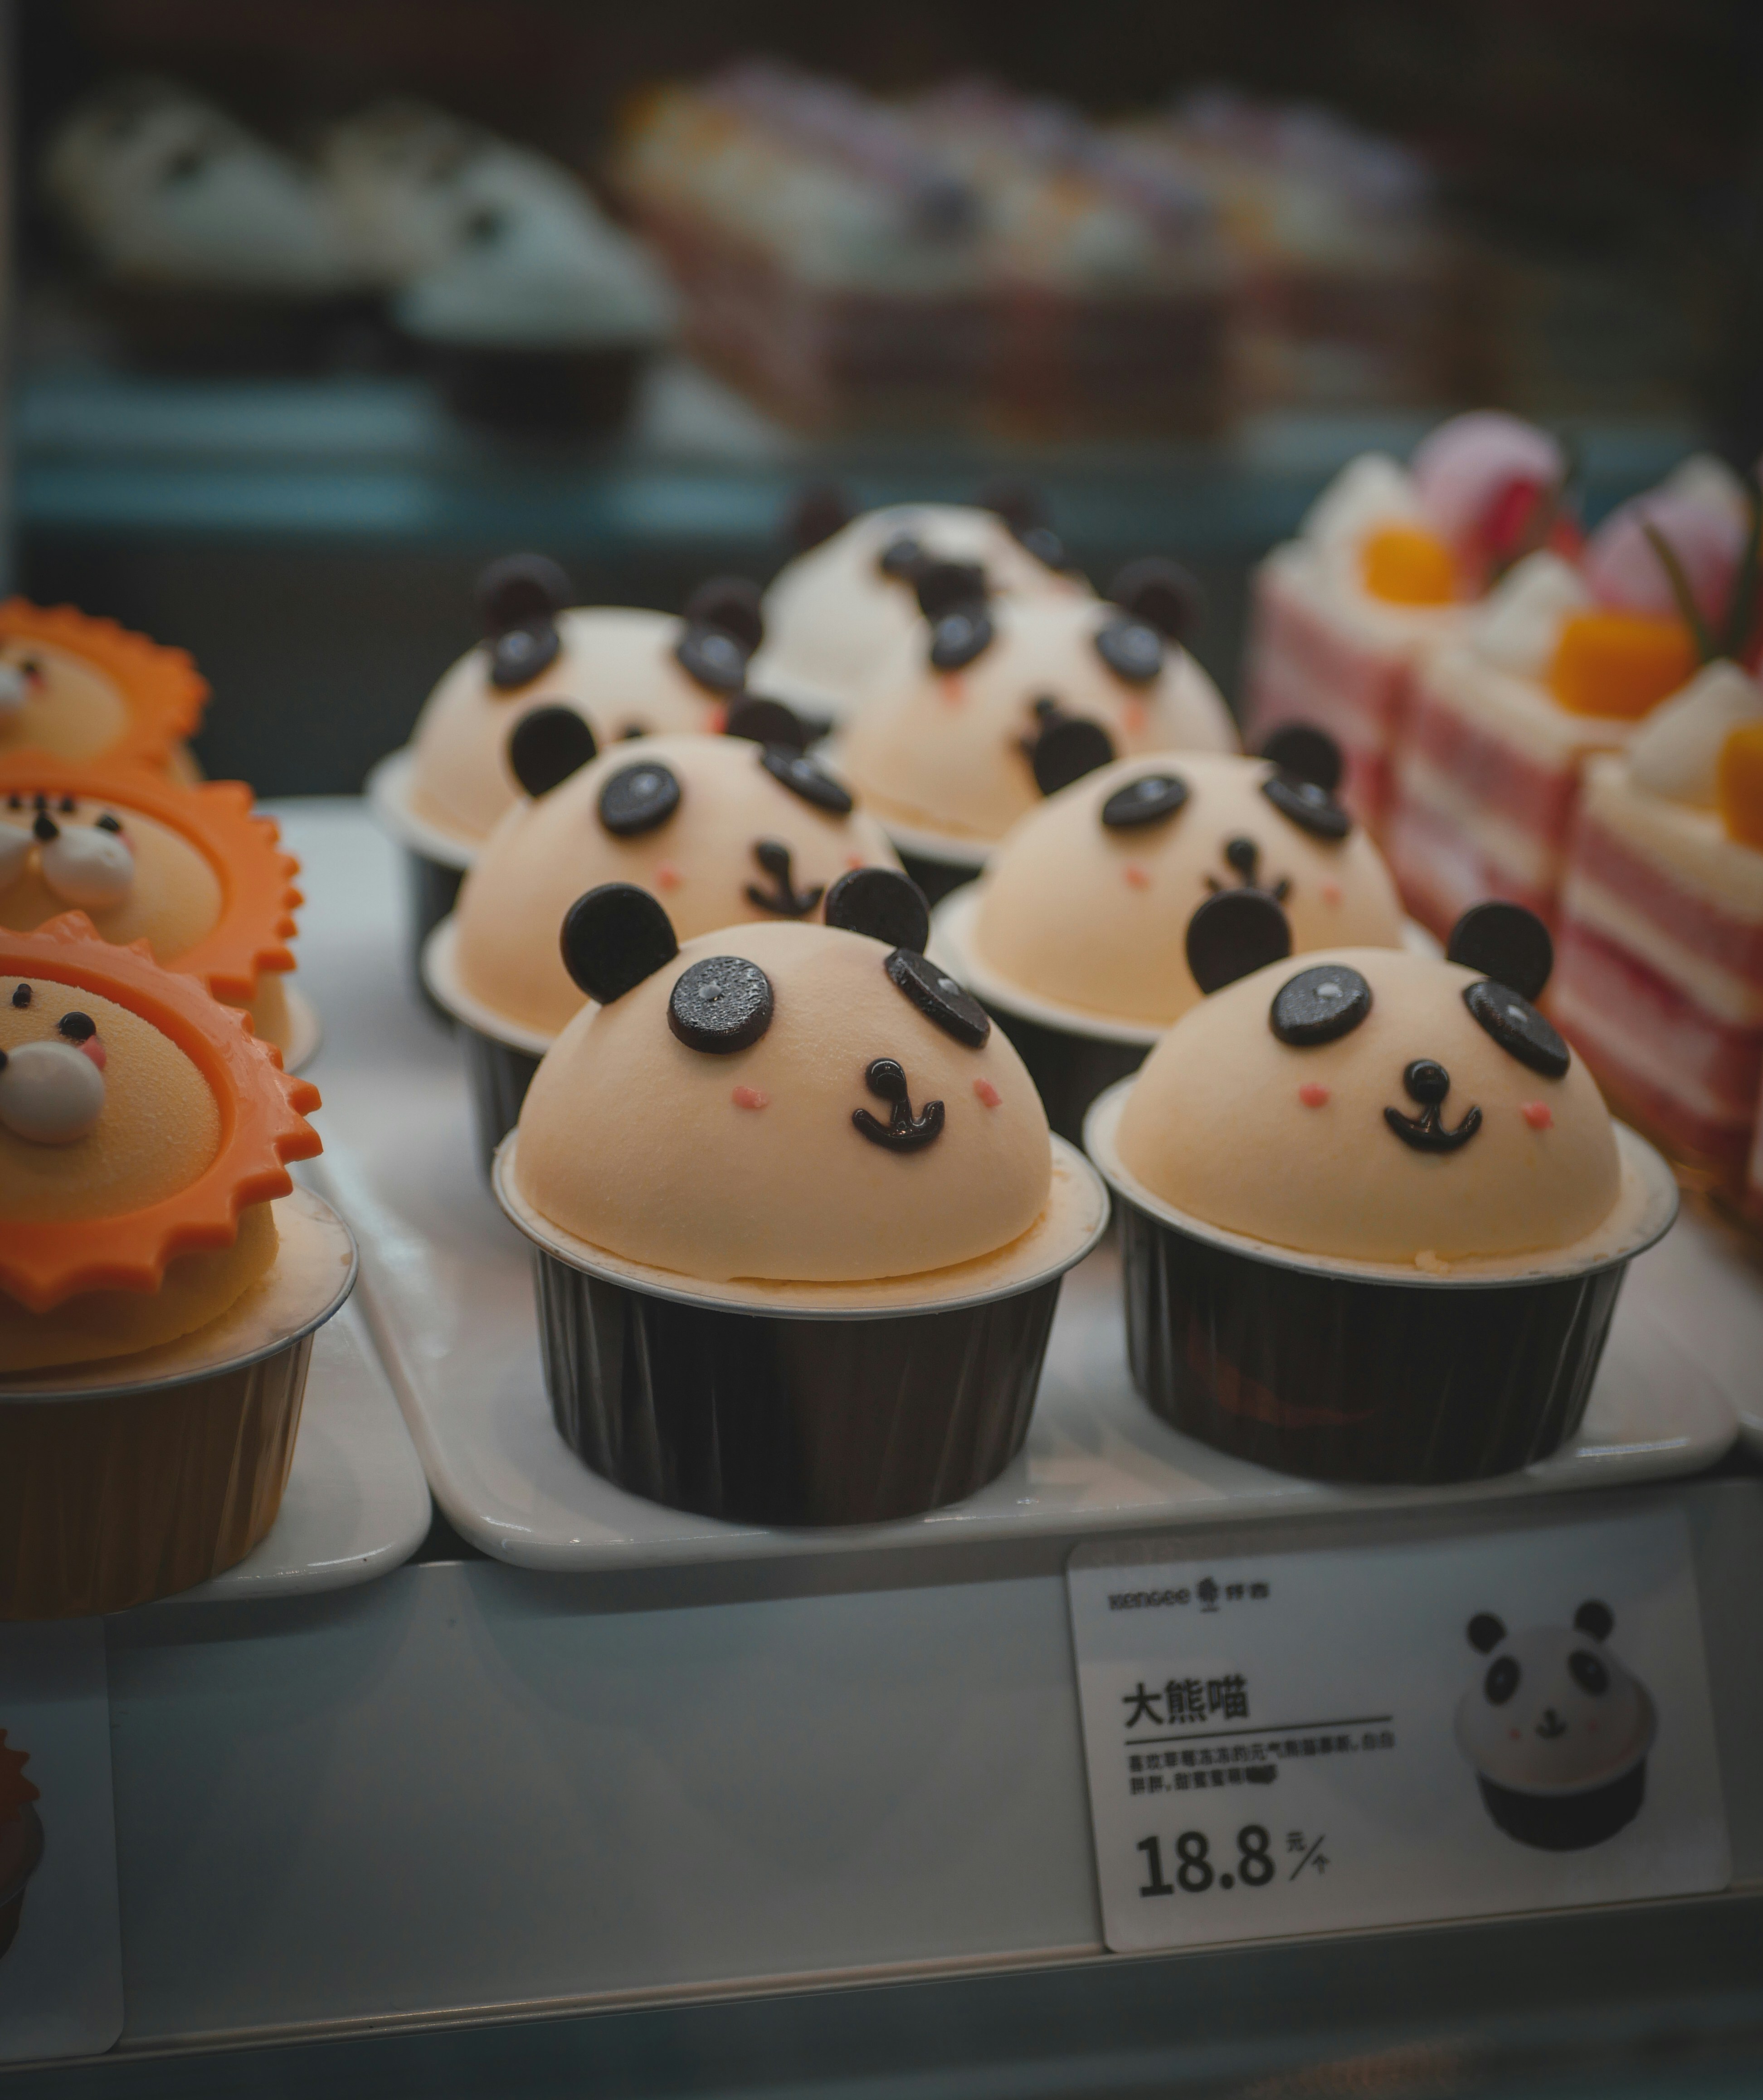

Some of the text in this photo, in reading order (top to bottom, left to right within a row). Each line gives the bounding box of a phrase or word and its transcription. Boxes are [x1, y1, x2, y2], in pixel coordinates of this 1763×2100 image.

[1122, 1673, 1250, 1728] 大熊喵
[1137, 1824, 1276, 1897] 18.8
